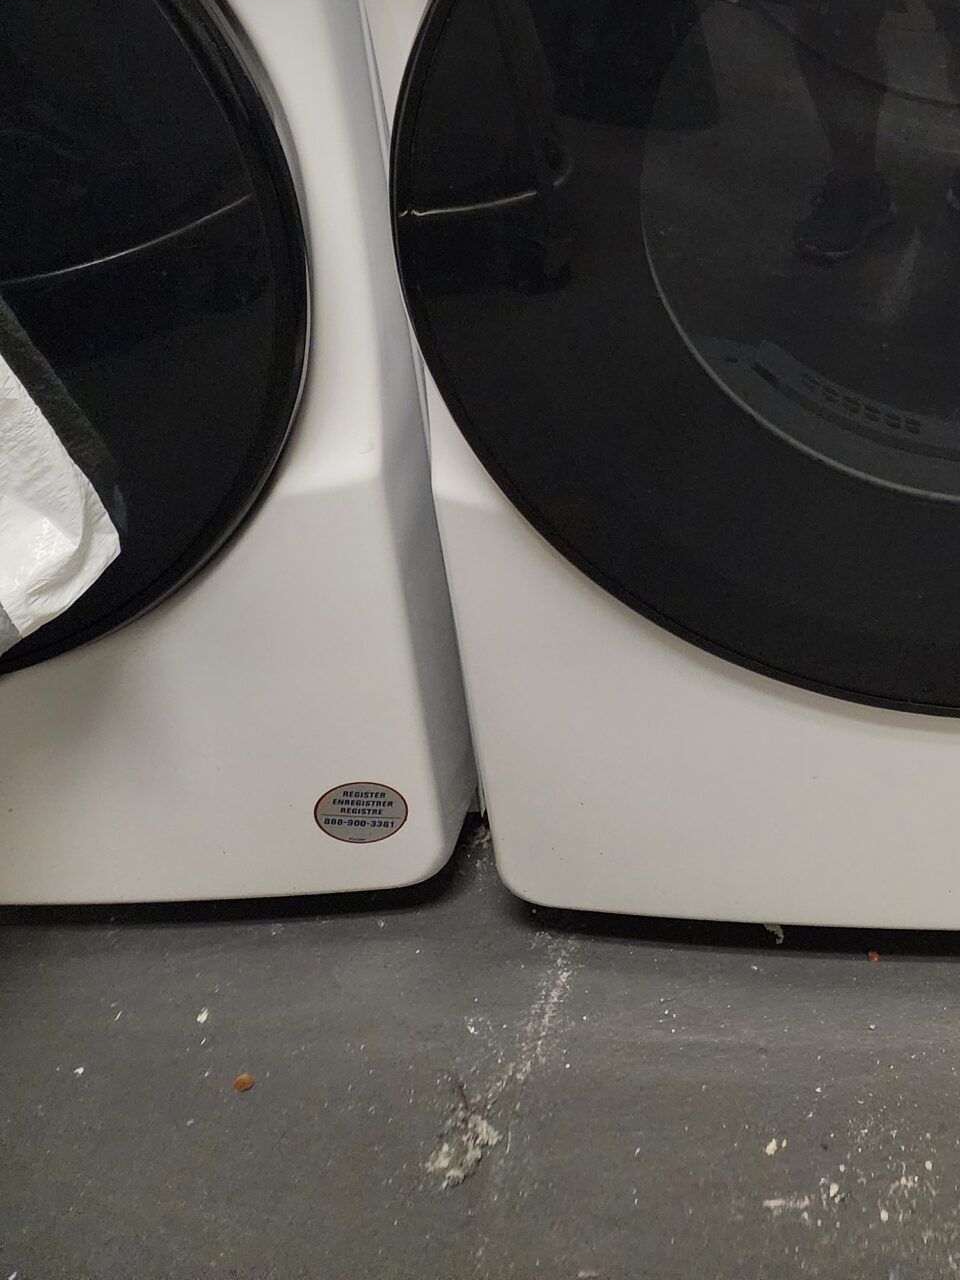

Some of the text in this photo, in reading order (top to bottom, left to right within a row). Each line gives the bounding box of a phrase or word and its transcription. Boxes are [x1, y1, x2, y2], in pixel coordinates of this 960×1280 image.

[342, 791, 386, 799] REGISTER
[332, 799, 393, 807] ENREGISTRER
[340, 807, 384, 815] REGISTRE
